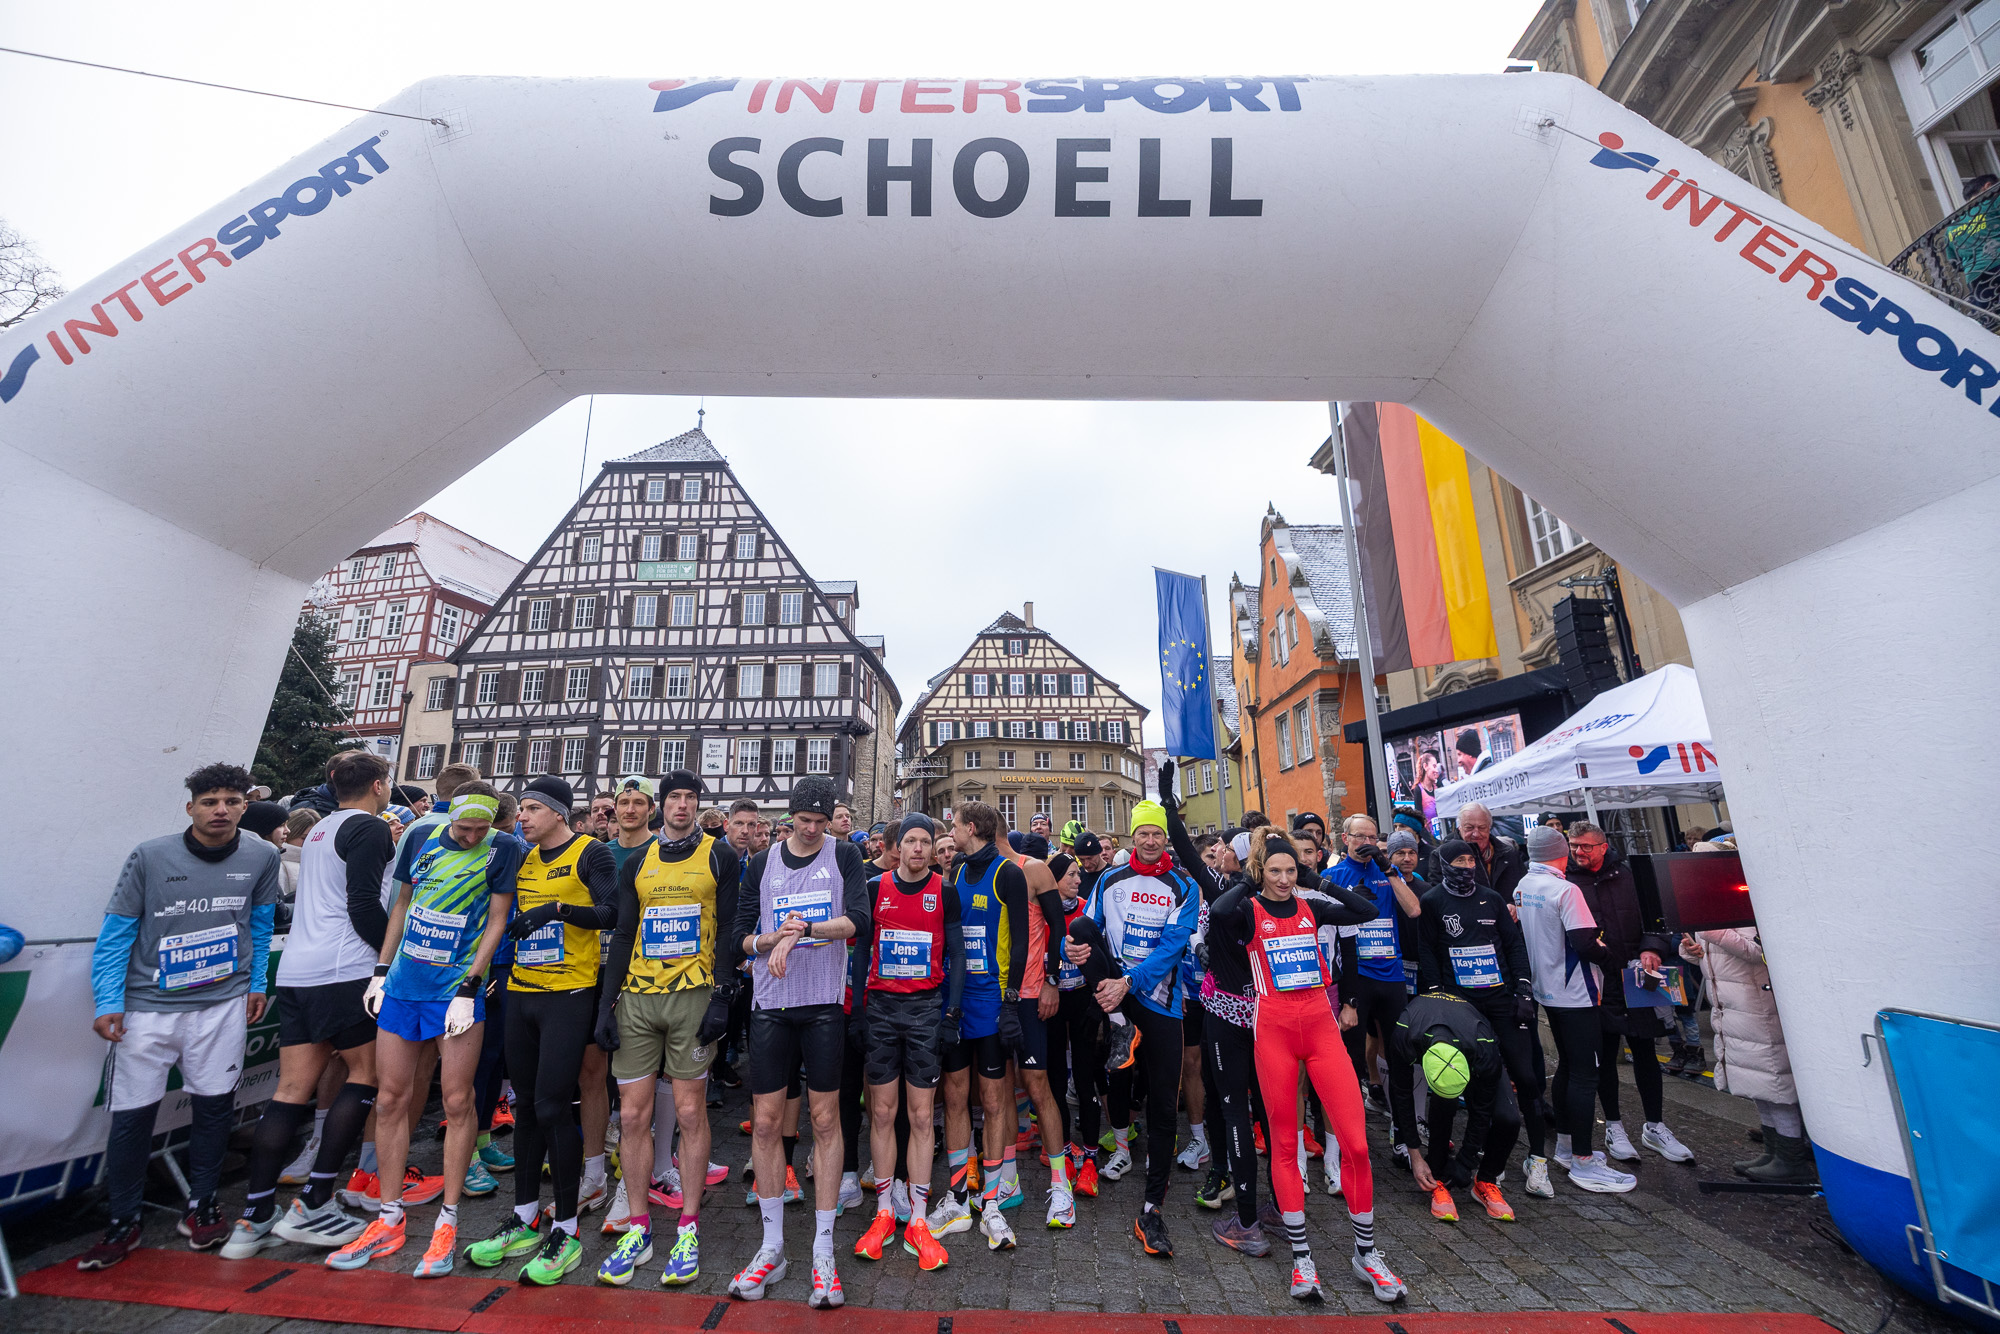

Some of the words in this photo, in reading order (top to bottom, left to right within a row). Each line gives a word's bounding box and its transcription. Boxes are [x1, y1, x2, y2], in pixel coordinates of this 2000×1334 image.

[747, 79, 1310, 114] INTERSPORT
[707, 136, 1264, 219] SCHOELL
[46, 135, 390, 366] INTERSPORT
[1645, 168, 2000, 419] INTERSPOR
[1001, 775, 1037, 784] LOEWEN
[1039, 775, 1086, 785] APOTHEKE
[1457, 790, 1468, 804] AUS
[1469, 785, 1487, 802] LIEBE
[1488, 782, 1504, 798] ZUM
[1504, 771, 1531, 792] SPORT
[165, 875, 188, 883] JAKO
[187, 898, 210, 913] 40.
[972, 894, 988, 909] SVA
[411, 919, 455, 940] Thorben
[521, 926, 556, 940] nnik
[652, 919, 690, 933] Heiko
[1126, 925, 1161, 939] Andreas
[1358, 928, 1392, 938] Matthias
[421, 939, 431, 947] 15
[530, 942, 538, 950] 21
[890, 942, 919, 956] Jens
[170, 942, 229, 964] Hamza
[1272, 949, 1316, 965] Kristina
[195, 959, 208, 969] 37
[900, 957, 908, 965] 18
[1296, 964, 1302, 972] 3
[1456, 957, 1494, 969] Kay-Uwe
[351, 1237, 383, 1259] BROOKS
